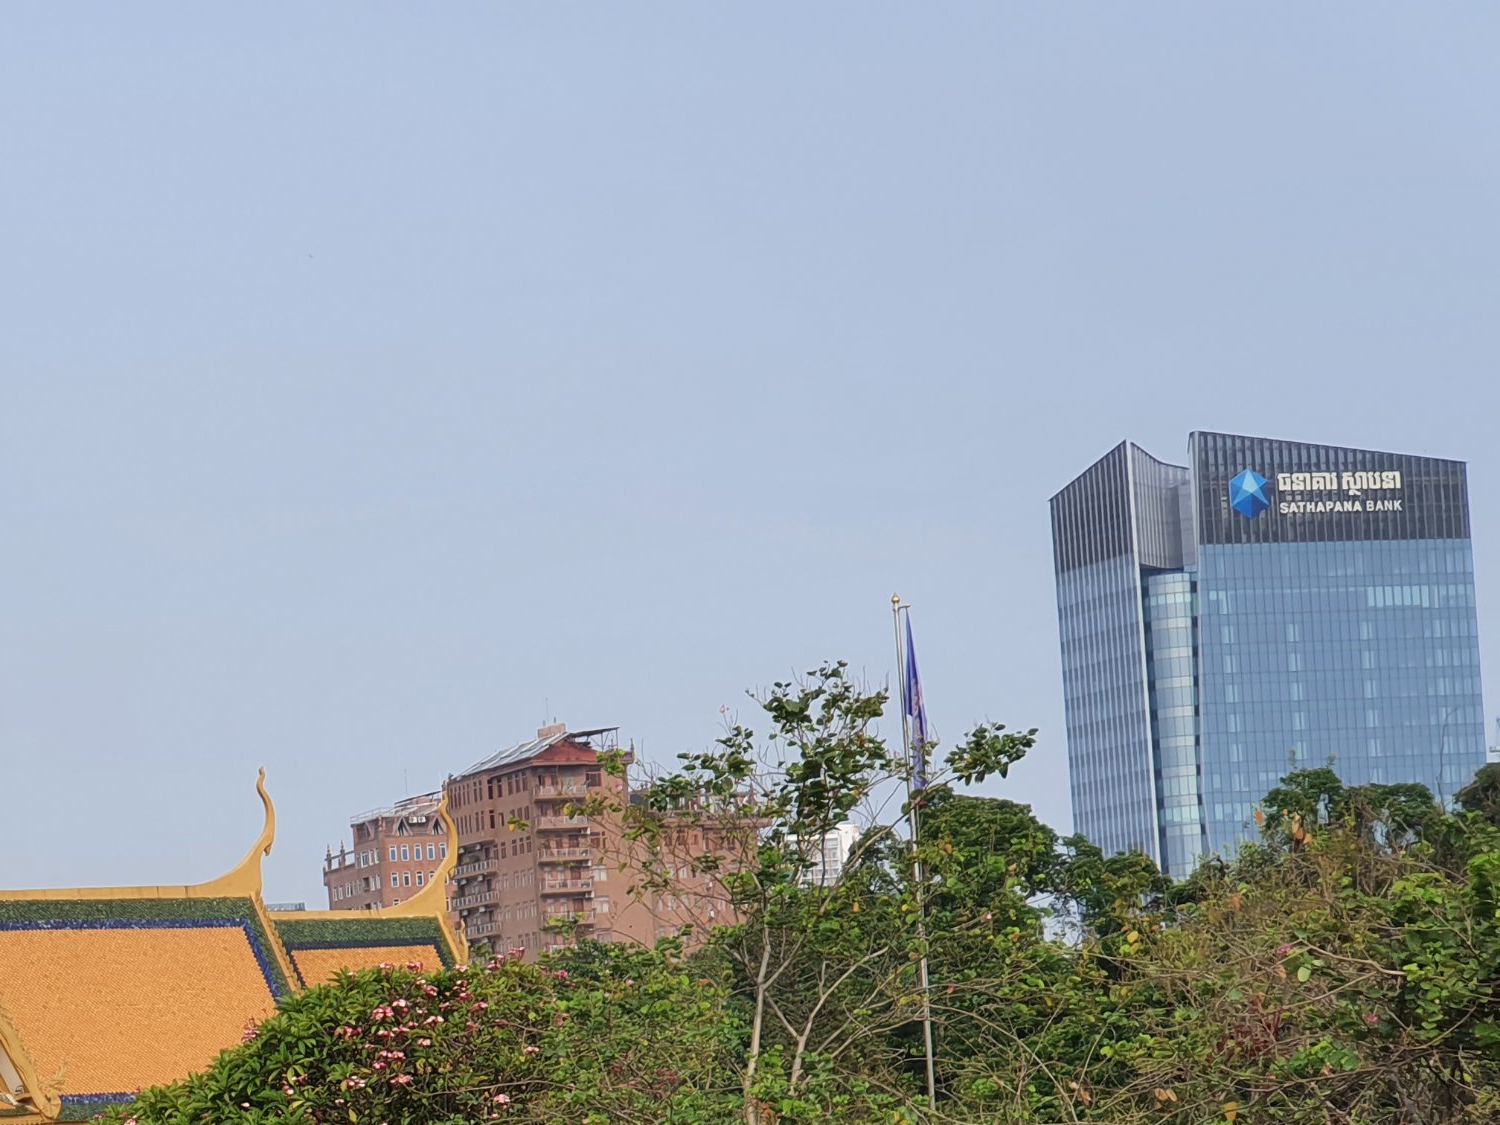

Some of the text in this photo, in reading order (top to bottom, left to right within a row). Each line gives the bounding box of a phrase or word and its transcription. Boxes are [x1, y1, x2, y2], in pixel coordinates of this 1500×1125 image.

[1277, 470, 1402, 496] ធនាគារ ស្ថាបនា
[1279, 499, 1403, 514] SATHAPANA BANK
